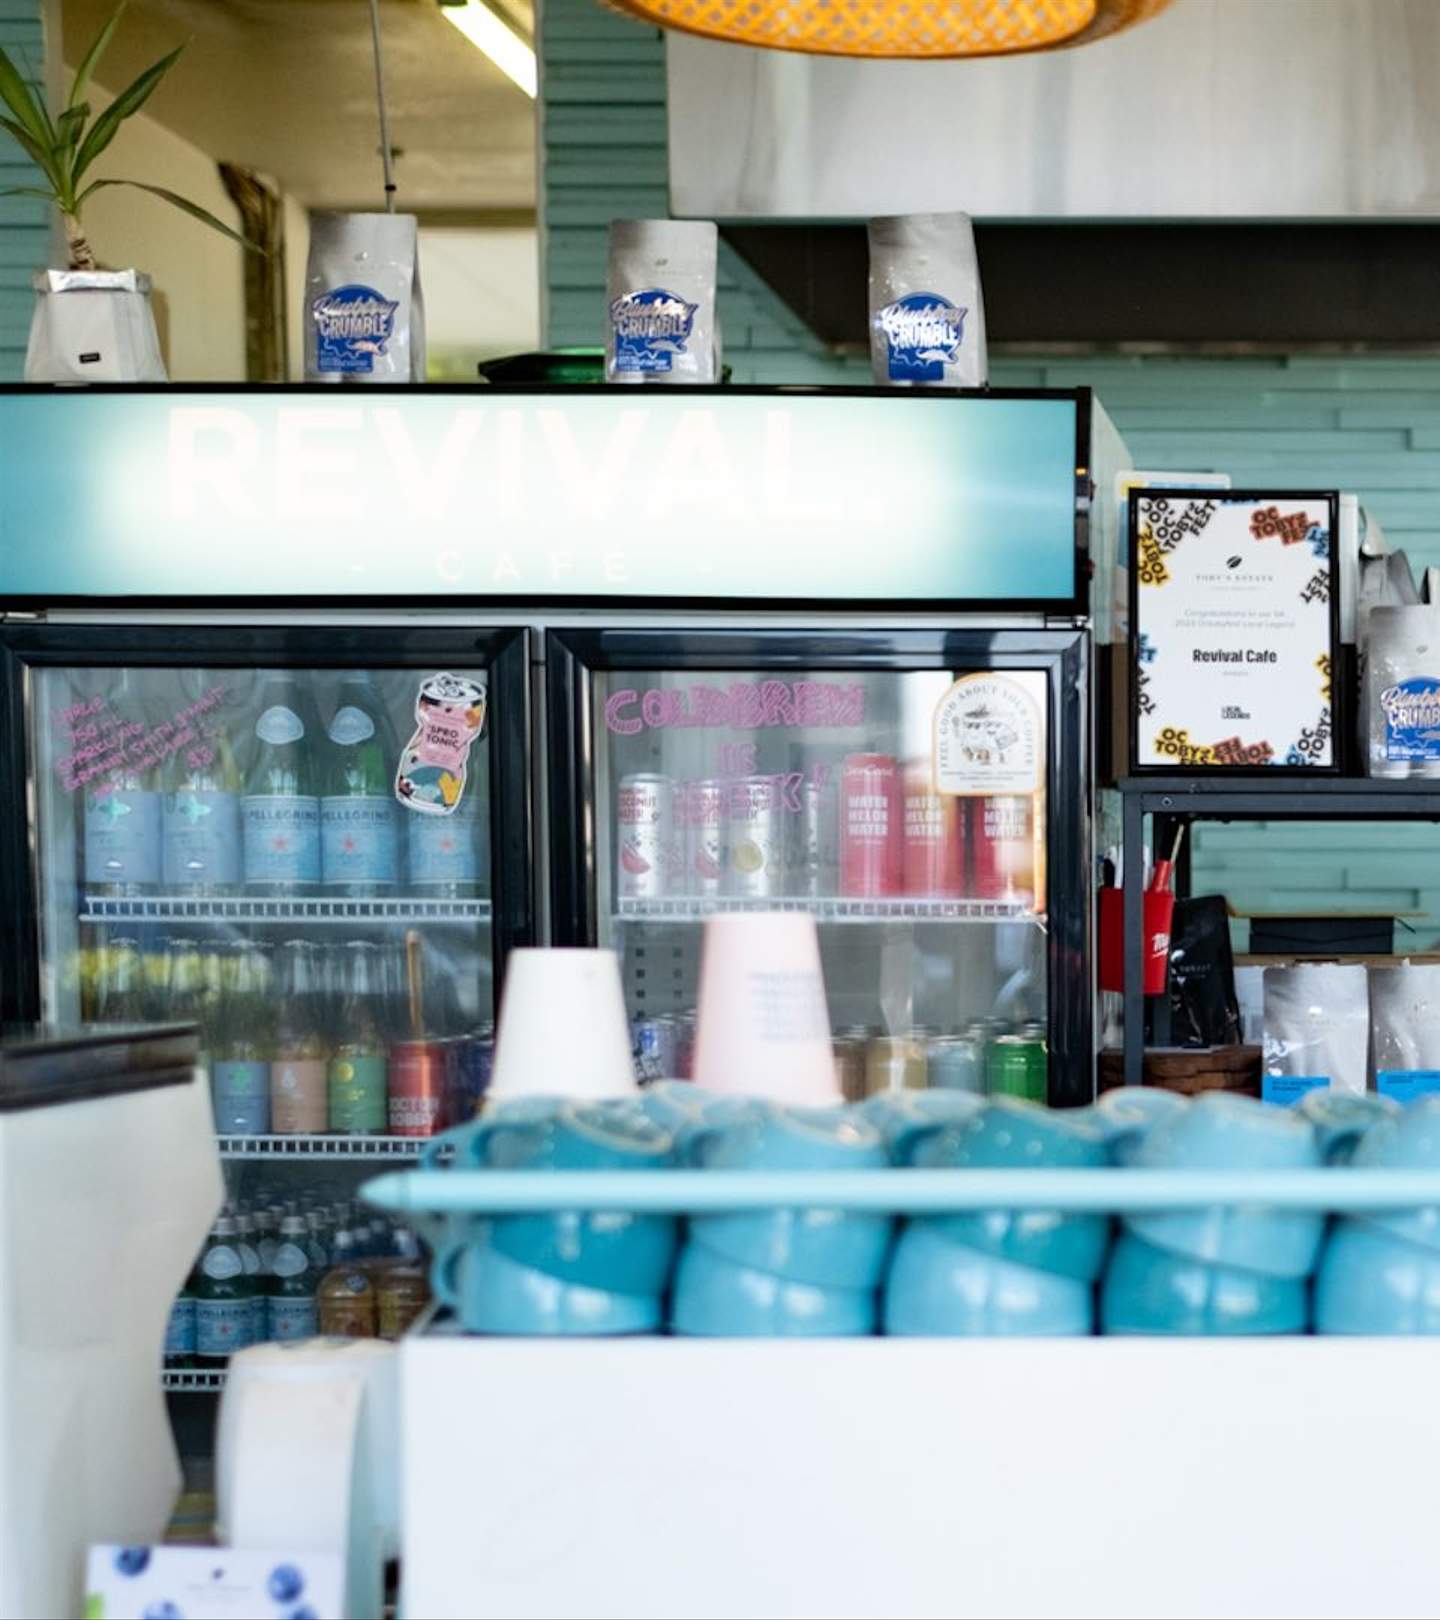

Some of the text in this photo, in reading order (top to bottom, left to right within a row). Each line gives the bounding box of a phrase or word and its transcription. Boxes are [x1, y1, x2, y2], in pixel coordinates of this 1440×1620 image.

[320, 314, 389, 338] CRUMBLE
[618, 314, 688, 337] CRUMBLE
[435, 549, 631, 584] CAFE
[1193, 648, 1277, 663] Revival Cafe
[1162, 728, 1187, 743] OC
